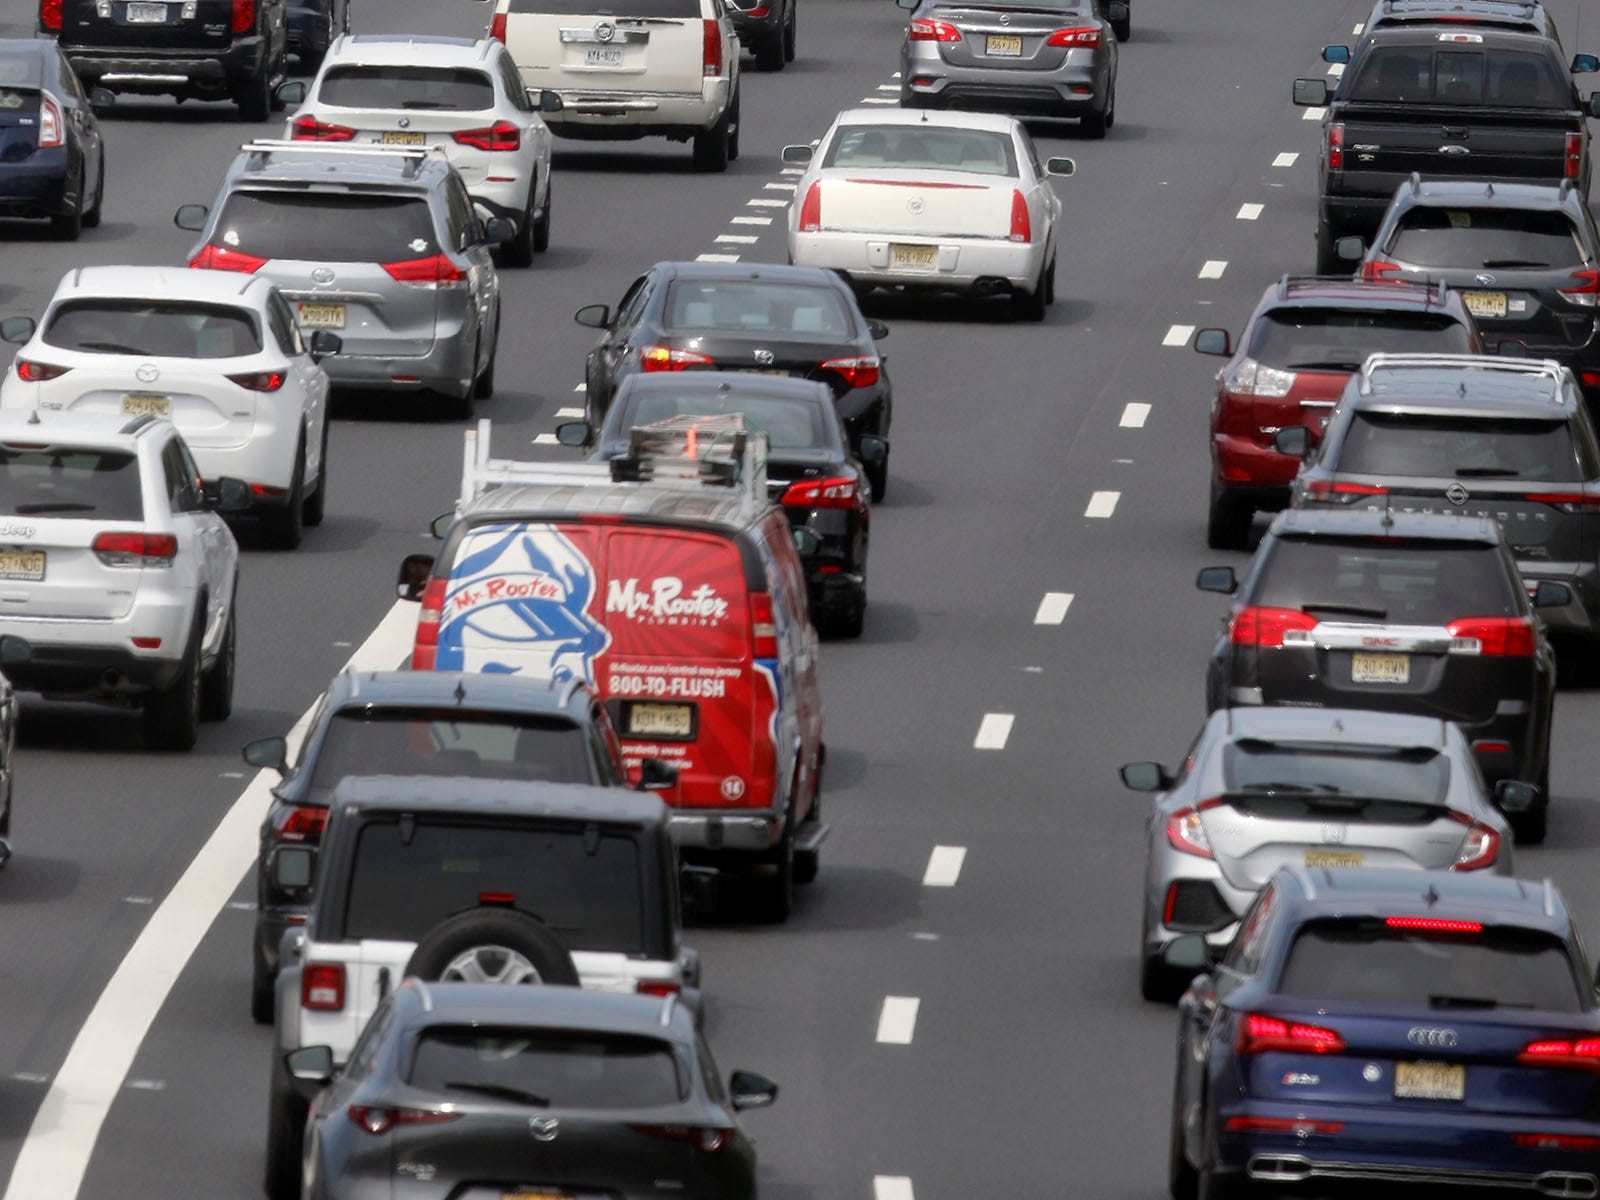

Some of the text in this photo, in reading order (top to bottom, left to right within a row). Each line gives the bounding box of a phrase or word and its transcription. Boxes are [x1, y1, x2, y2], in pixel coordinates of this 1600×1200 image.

[486, 577, 560, 599] Rooter
[1361, 636, 1400, 648] GMC
[608, 674, 726, 699] 800-TO-FLUSH
